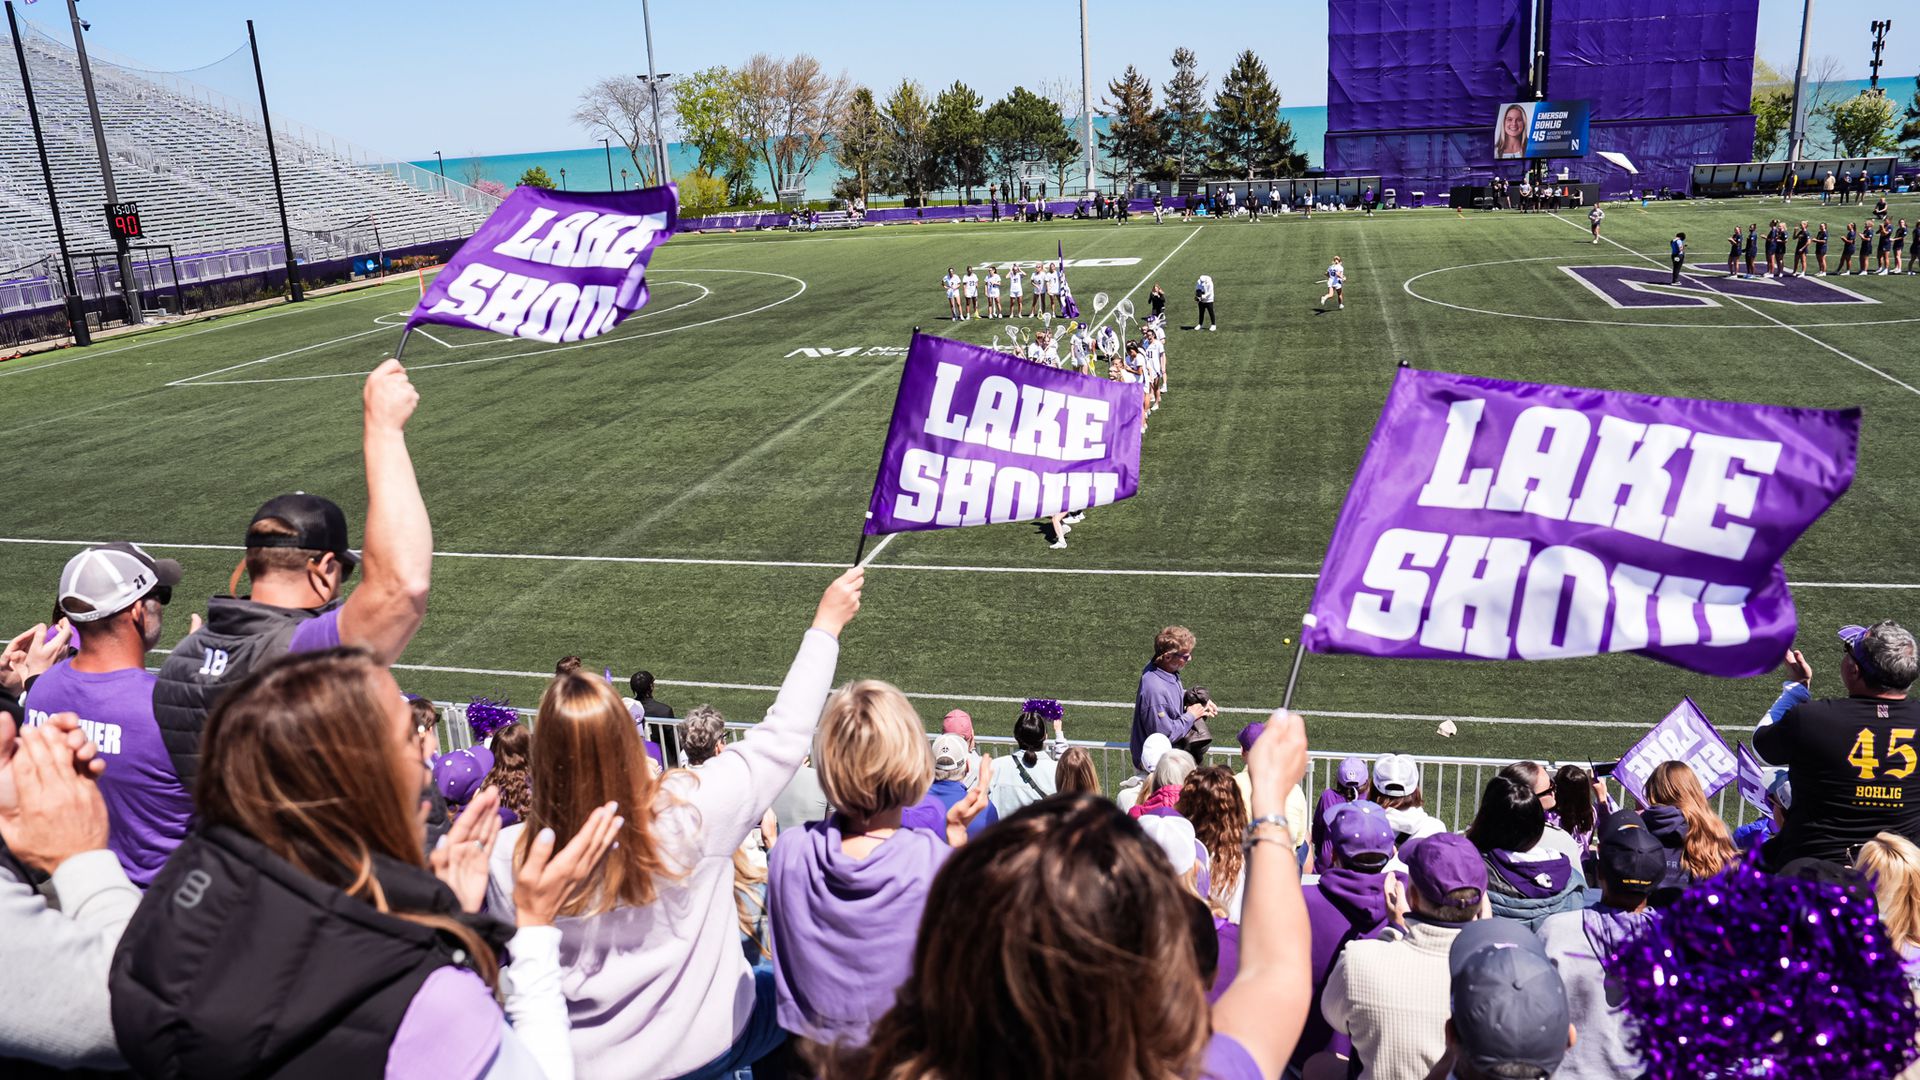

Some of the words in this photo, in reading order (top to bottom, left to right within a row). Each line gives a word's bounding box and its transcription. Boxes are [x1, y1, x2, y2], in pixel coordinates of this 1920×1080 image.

[1537, 111, 1569, 120] EMERSON
[1534, 120, 1562, 129] BOHLIG
[1532, 130, 1546, 142] 45
[1571, 139, 1580, 151] N
[112, 204, 136, 215] 15:00
[115, 215, 138, 235] 90
[493, 207, 667, 269] LAKE
[923, 361, 1110, 461] LAKE
[1416, 398, 1783, 561] LAKE
[199, 647, 229, 676] 18
[1848, 728, 1918, 779] 45
[1855, 786, 1902, 799] BOHLIG
